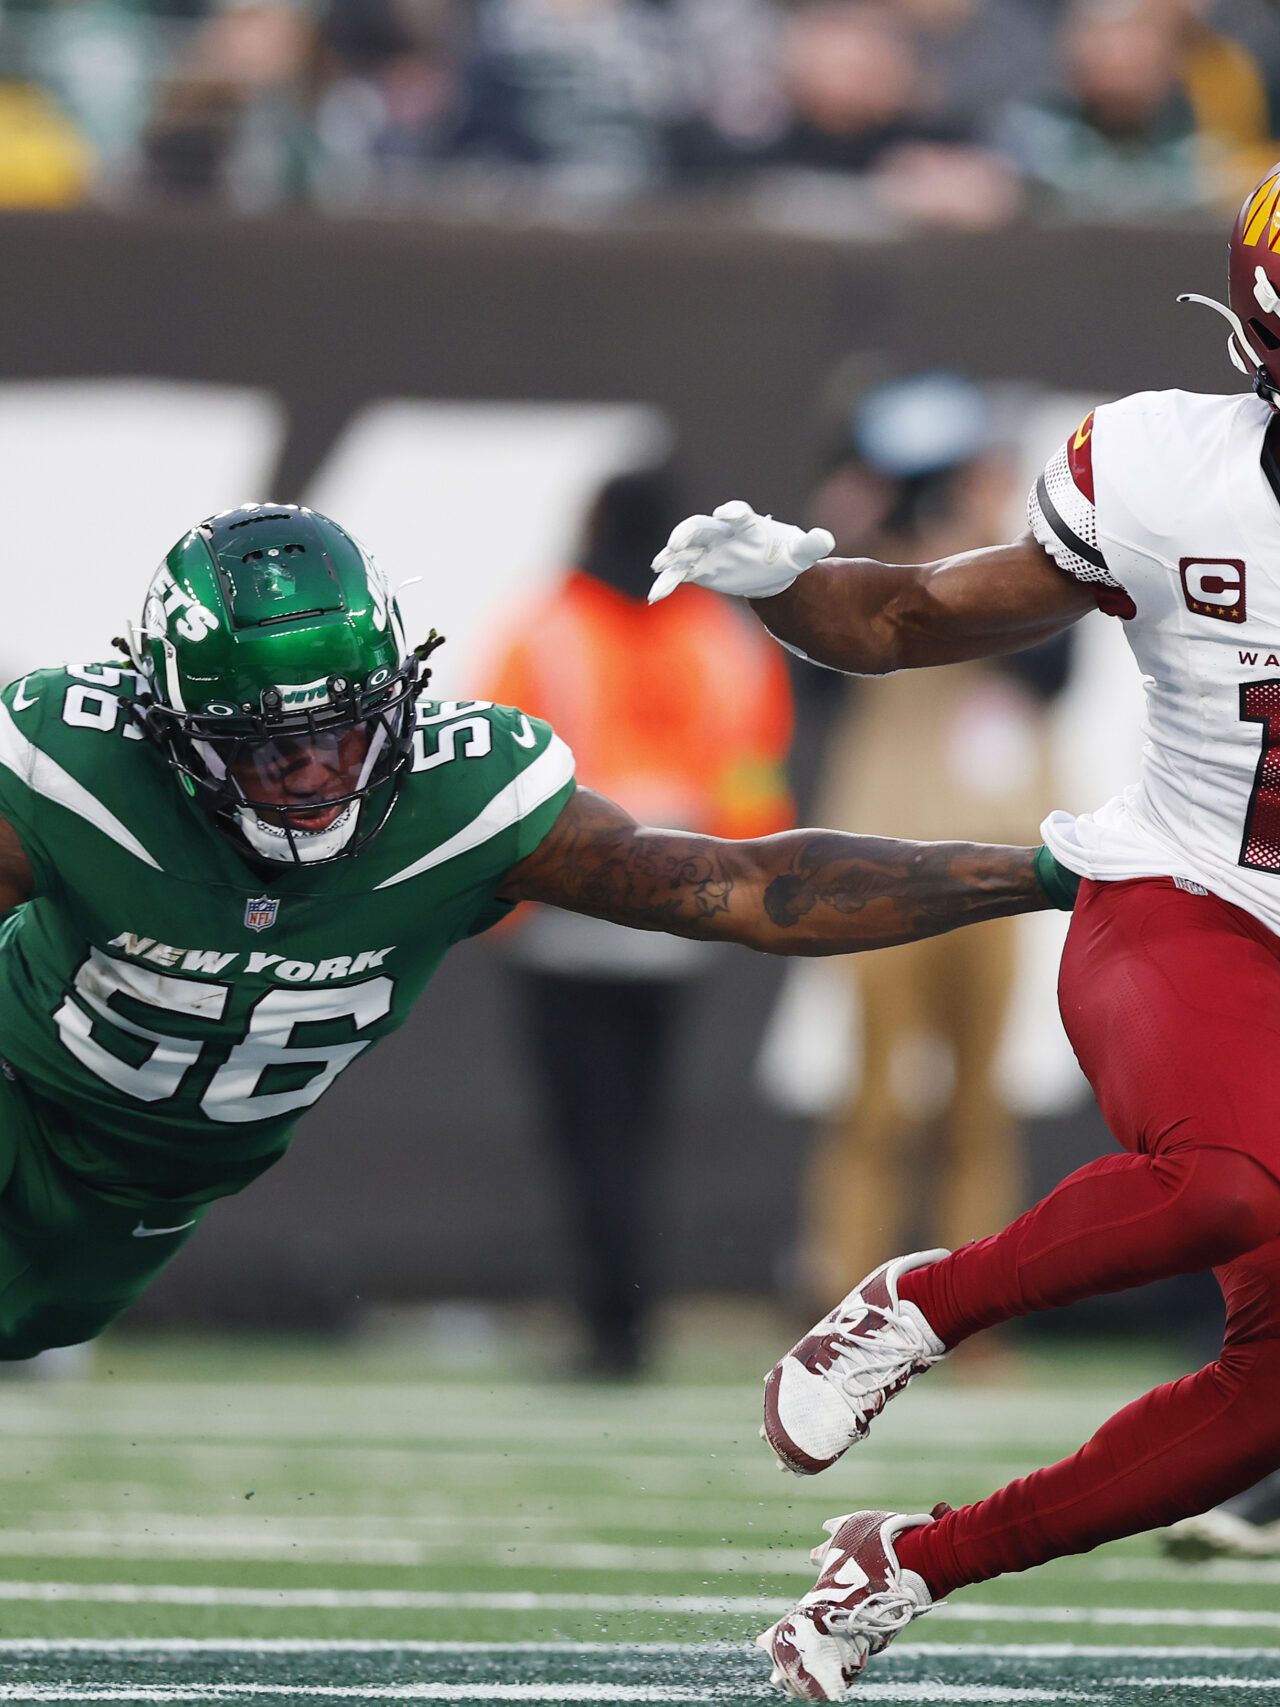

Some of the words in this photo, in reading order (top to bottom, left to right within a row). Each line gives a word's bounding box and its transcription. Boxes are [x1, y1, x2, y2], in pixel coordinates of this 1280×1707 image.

[1185, 563, 1241, 607] C
[249, 911, 272, 925] NFL
[107, 931, 240, 974] NEW
[243, 946, 397, 982] YORK
[52, 945, 395, 1123] 56
